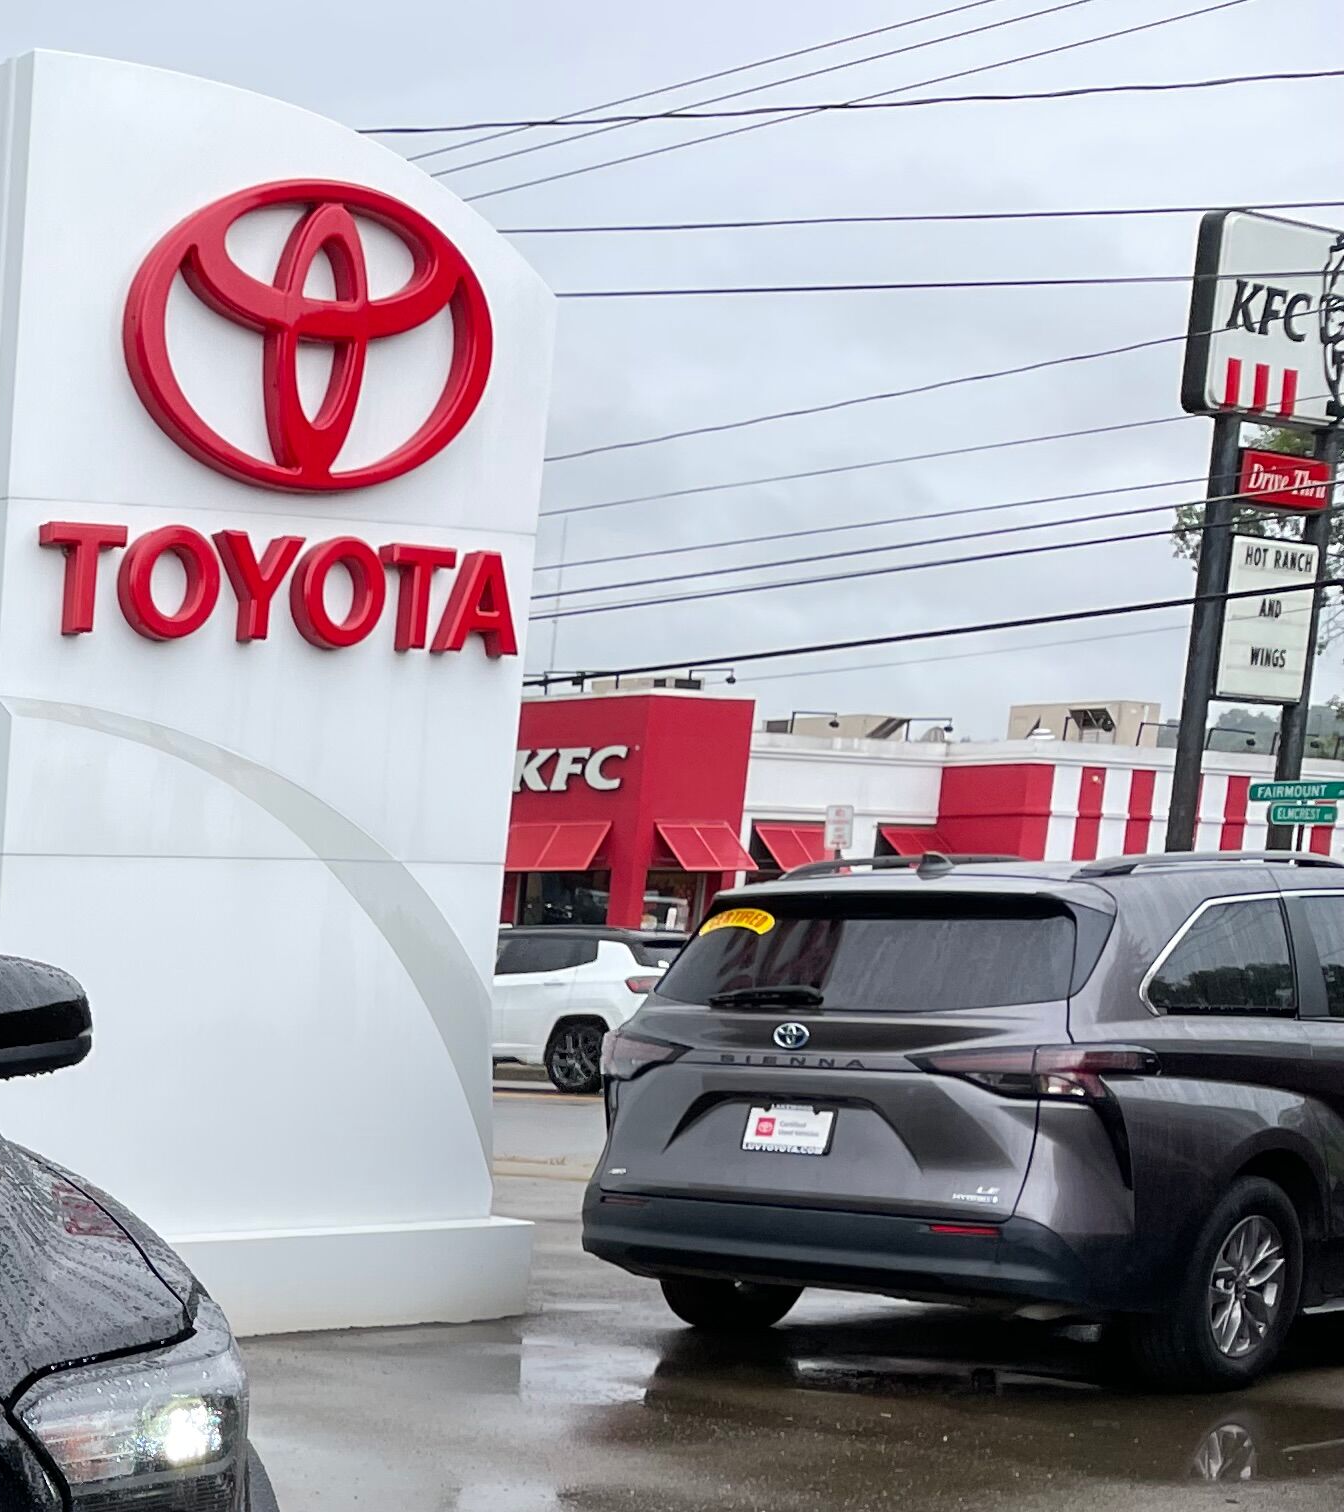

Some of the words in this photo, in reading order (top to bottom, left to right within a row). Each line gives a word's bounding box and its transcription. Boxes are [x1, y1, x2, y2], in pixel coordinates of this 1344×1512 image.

[1226, 279, 1311, 342] KFC
[1248, 463, 1290, 491] Drive
[1292, 469, 1326, 499] Thru
[1245, 545, 1269, 568] HOT
[1274, 550, 1314, 573] RANCH
[39, 521, 518, 658] TOYOTA
[1258, 598, 1282, 618] AND
[1250, 646, 1287, 668] WINGS
[512, 745, 629, 793] KFC
[1257, 784, 1327, 799] FAIRMOUNT
[1277, 807, 1321, 820] ELMCREST
[720, 1054, 865, 1069] SIENNA
